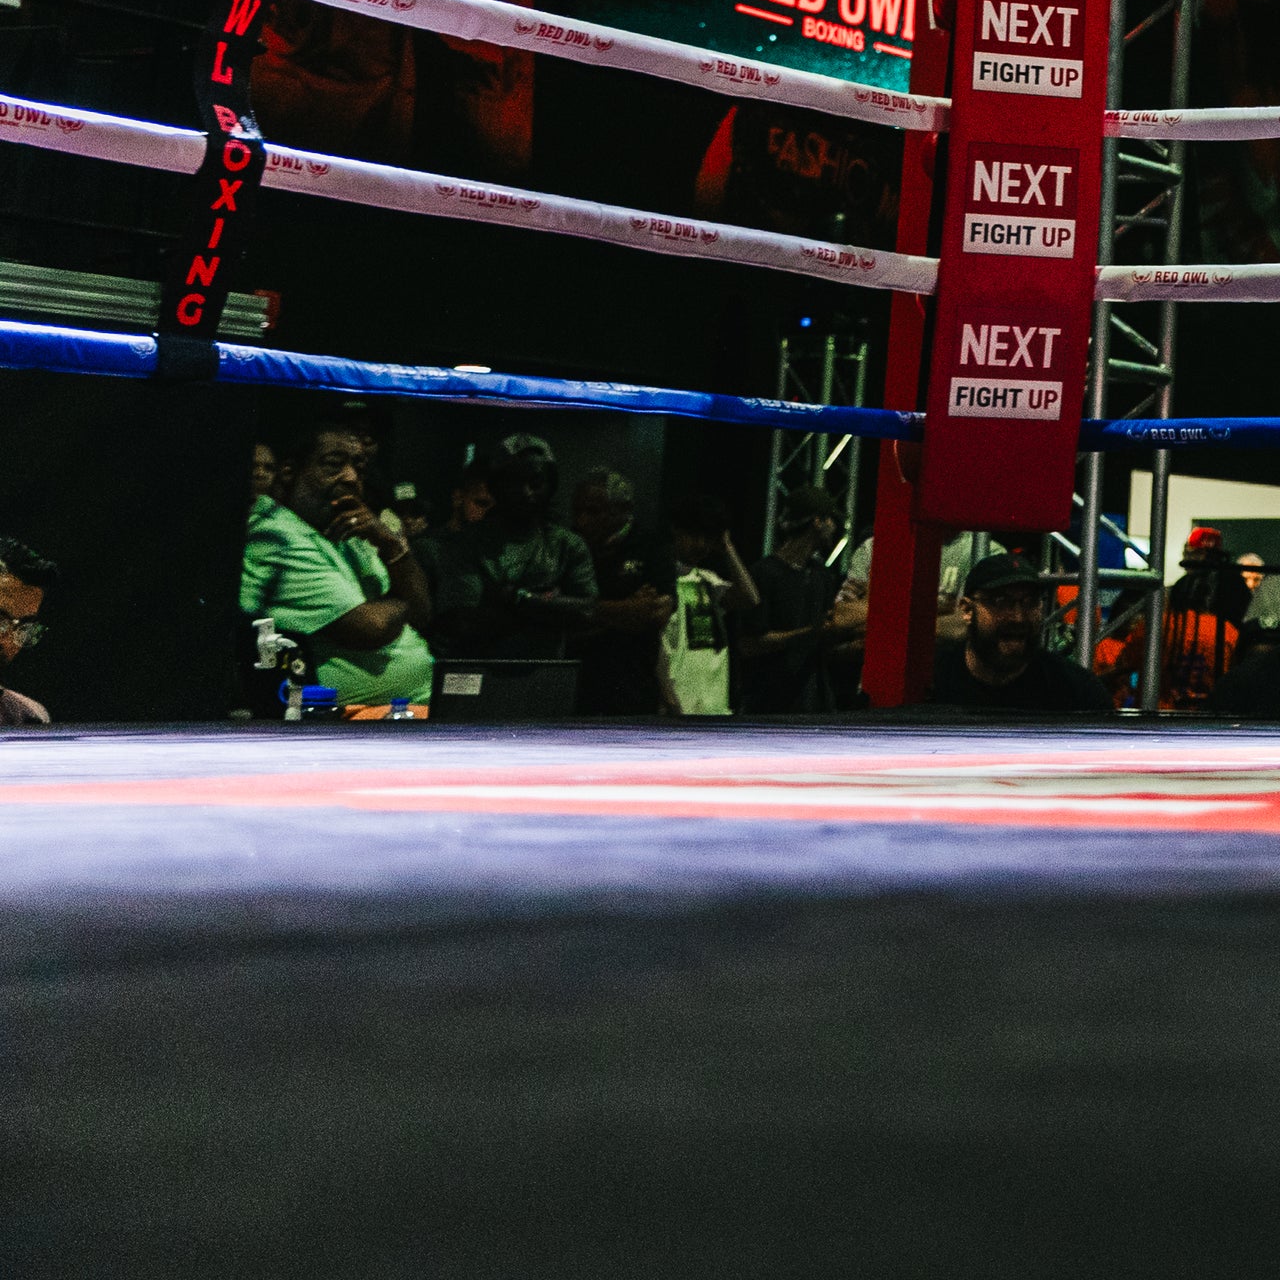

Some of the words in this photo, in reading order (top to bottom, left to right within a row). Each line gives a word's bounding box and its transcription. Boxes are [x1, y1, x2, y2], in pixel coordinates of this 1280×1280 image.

[537, 22, 565, 40] RED
[564, 31, 592, 48] OWL
[802, 15, 865, 53] BOXING
[981, 0, 1080, 48] NEXT
[715, 59, 738, 77] RED
[739, 65, 762, 83] OWL
[979, 60, 1045, 85] FIGHT
[1050, 66, 1080, 88] UP
[870, 90, 892, 108] RED
[891, 93, 912, 111] OWL
[14, 104, 51, 126] OWL
[972, 160, 1073, 207] NEXT
[176, 103, 252, 326] BOXING
[649, 218, 672, 235] RED
[674, 222, 698, 239] OWL
[969, 221, 1036, 246] FIGHT
[1041, 226, 1072, 248] UP
[817, 247, 838, 263] RED
[837, 251, 858, 268] OWL
[1153, 271, 1179, 284] RED
[1181, 271, 1209, 285] OWL
[959, 323, 1062, 369] NEXT
[955, 385, 1023, 409] FIGHT
[1028, 388, 1059, 410] UP
[1150, 428, 1177, 441] RED
[1179, 427, 1208, 441] OWL
